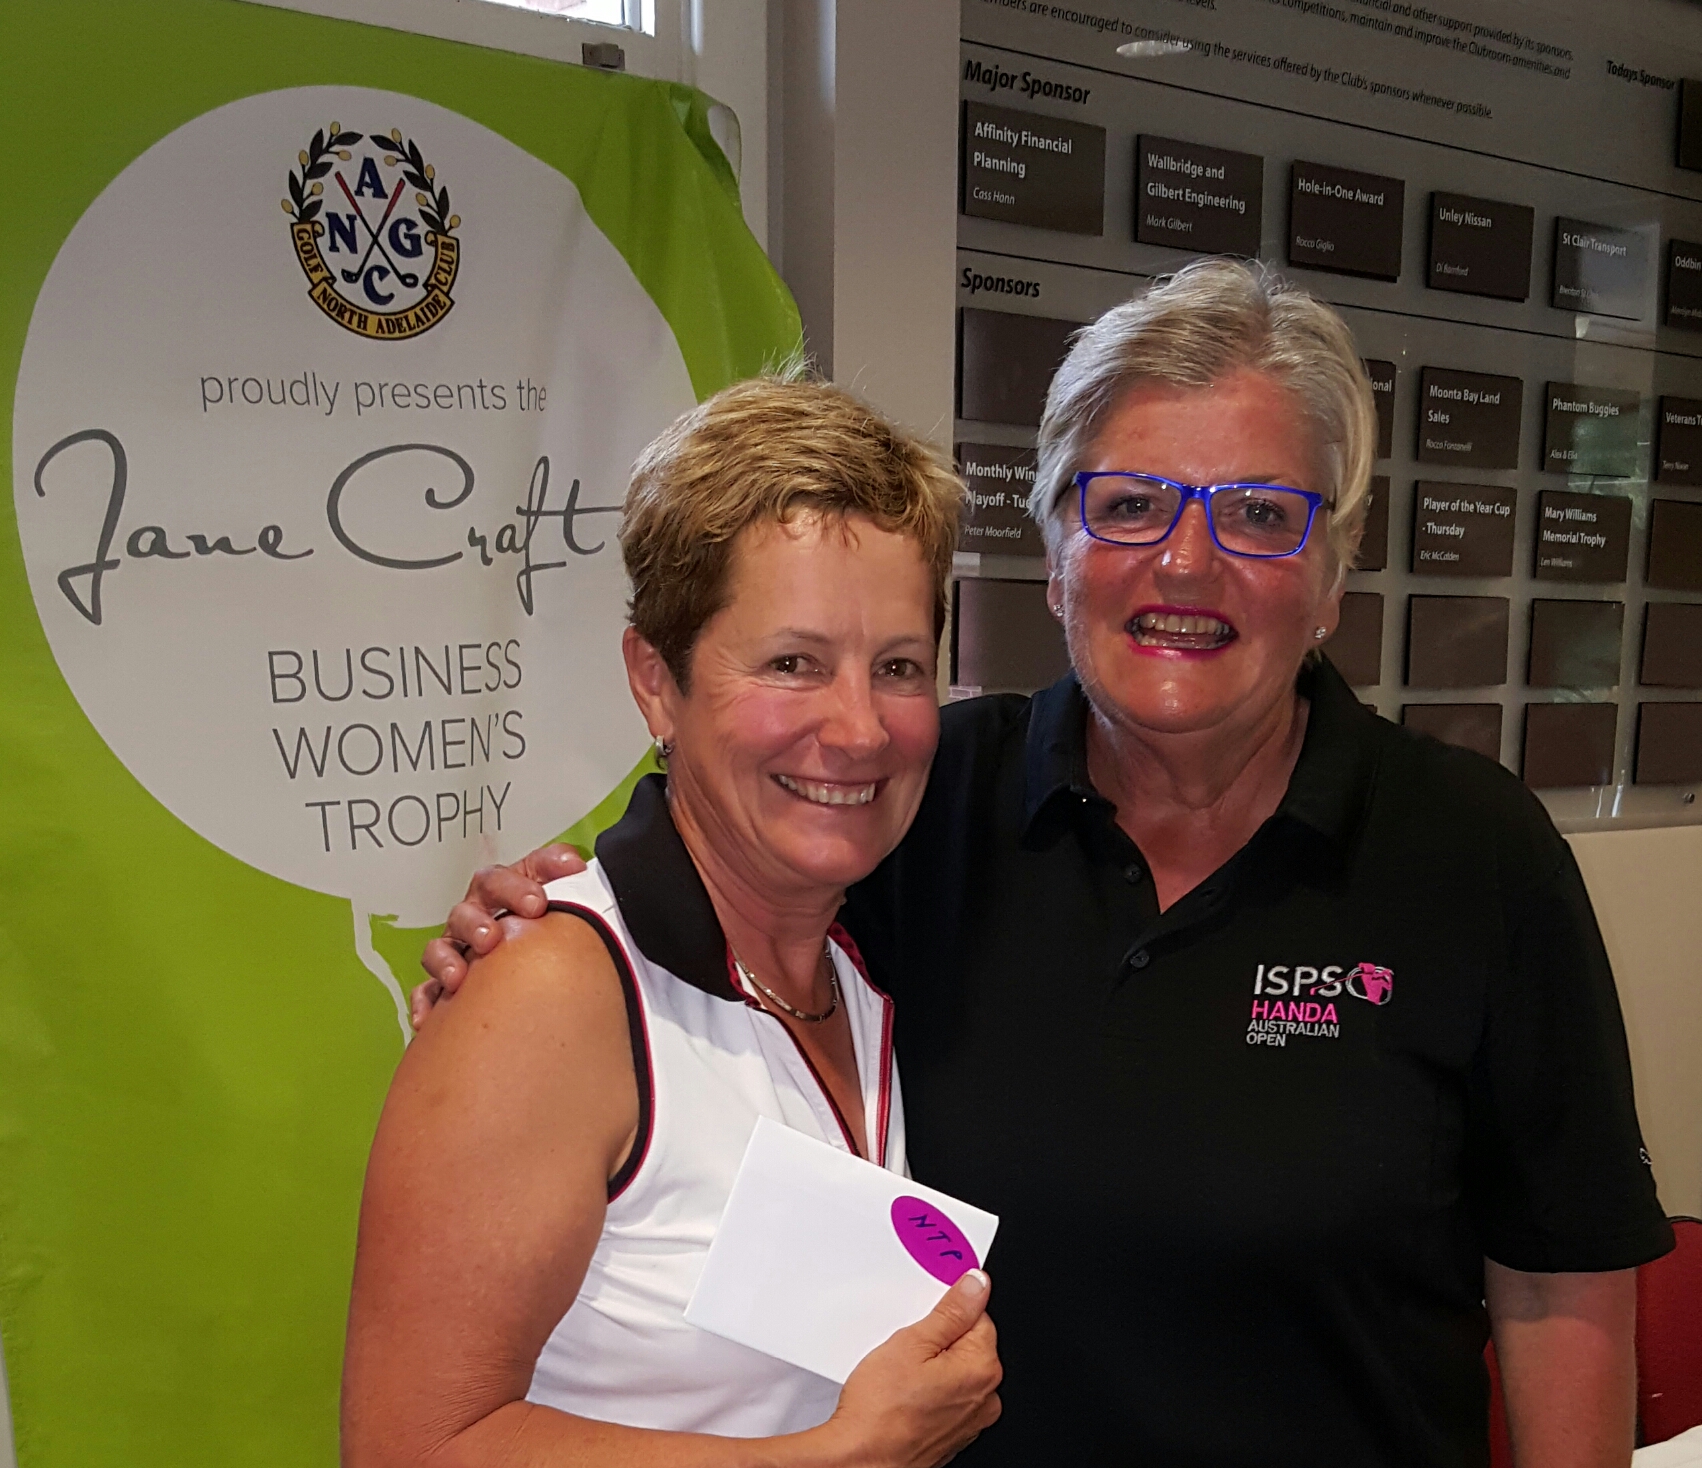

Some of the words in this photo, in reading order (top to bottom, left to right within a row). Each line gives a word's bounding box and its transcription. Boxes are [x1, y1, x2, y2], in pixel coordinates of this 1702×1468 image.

[1393, 3, 1411, 16] and
[1413, 8, 1437, 23] other
[1439, 15, 1472, 32] support
[1473, 25, 1512, 43] provided
[1513, 32, 1523, 49] by
[1525, 37, 1534, 50] its
[1030, 2, 1048, 15] are
[1051, 7, 1118, 33] encouraged
[1121, 20, 1132, 35] to
[1135, 26, 1180, 46] consider
[1182, 37, 1211, 56] using
[1214, 41, 1230, 58] the
[1233, 49, 1271, 67] services
[1273, 57, 1307, 77] offered
[1310, 66, 1321, 82] by
[1324, 68, 1339, 82] the
[1370, 81, 1410, 101] sponsors
[1412, 90, 1455, 110] whenever
[1350, 14, 1392, 31] maintain
[1395, 25, 1413, 38] and
[1415, 27, 1450, 48] improve
[1453, 38, 1468, 52] the
[1554, 68, 1570, 79] and
[964, 60, 1018, 91] Major
[1020, 72, 1090, 104] Sponsor
[1606, 60, 1638, 81] Todays
[1640, 70, 1675, 90] Sponsor
[974, 122, 1020, 148] Affinity
[1021, 131, 1073, 154] Financial
[354, 156, 389, 199] A
[973, 152, 1027, 179] Planning
[1147, 153, 1204, 180] Wallbridge
[1205, 166, 1225, 179] and
[1147, 182, 1183, 201] Gilbert
[1185, 188, 1246, 214] Engineering
[1298, 178, 1354, 202] Hole-in-One
[1356, 188, 1384, 206] Award
[1146, 214, 1166, 228] Mark
[1439, 206, 1463, 227] Unley
[1464, 211, 1492, 228] Nissan
[325, 212, 358, 254] N
[388, 217, 423, 258] G
[1562, 232, 1571, 245] St
[1571, 234, 1590, 250] Clair
[1590, 238, 1627, 258] Transport
[296, 229, 323, 274] GOLF
[435, 242, 455, 286] CLUB
[362, 264, 395, 305] C
[960, 267, 1041, 298] Sponsors
[316, 287, 368, 332] NORTH
[375, 293, 447, 335] ADELAIDE
[200, 371, 340, 416] proudly
[354, 378, 507, 416] presents
[516, 377, 547, 412] the
[1429, 384, 1462, 401] Moonta
[1463, 389, 1479, 405] Bay
[1480, 390, 1500, 404] Land
[1552, 397, 1587, 413] Phantom
[1588, 402, 1619, 418] Buggies
[1427, 409, 1450, 424] Sales
[1665, 411, 1696, 426] Veterans
[965, 462, 1013, 482] Monthly
[1423, 497, 1450, 515] Player
[1451, 500, 1460, 512] of
[1460, 501, 1475, 514] the
[1475, 501, 1494, 514] Year
[1494, 502, 1510, 517] Cup
[1544, 506, 1564, 521] Mary
[1564, 508, 1597, 523] Williams
[34, 428, 314, 626] Jane
[327, 443, 625, 615] Craft
[1426, 522, 1465, 539] Thursday
[1542, 530, 1579, 545] Memorial
[1579, 531, 1606, 548] Trophy
[267, 638, 524, 704] BUSINESS
[272, 709, 527, 780] WOMEN'S
[305, 781, 512, 853] TROPHY
[1253, 963, 1344, 998] ISPS
[1250, 999, 1339, 1024] HANDA
[1245, 1032, 1287, 1047] OPEN
[1246, 1019, 1341, 1039] AUSTRALIAN
[907, 1213, 963, 1260] NTP
